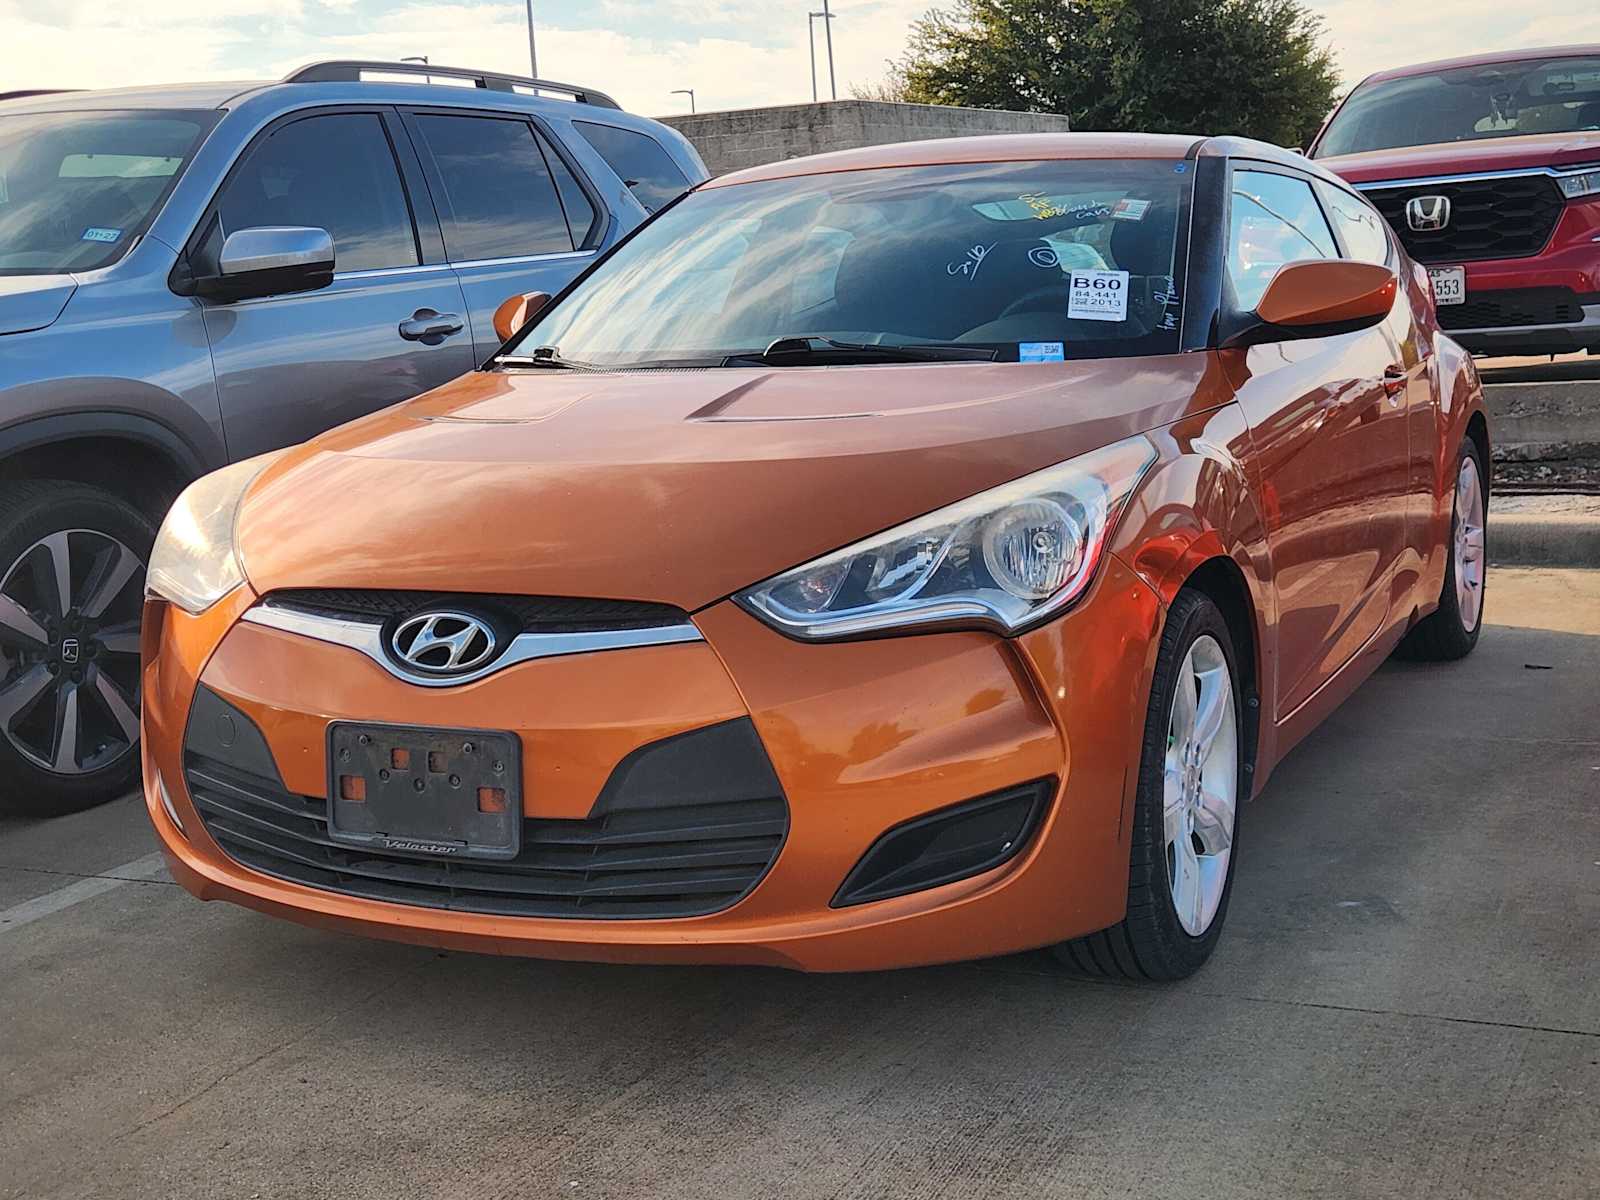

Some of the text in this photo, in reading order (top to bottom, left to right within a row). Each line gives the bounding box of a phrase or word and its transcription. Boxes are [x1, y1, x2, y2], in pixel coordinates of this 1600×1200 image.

[1074, 277, 1121, 290] B60
[1435, 279, 1459, 297] 553
[1090, 298, 1121, 307] 2013
